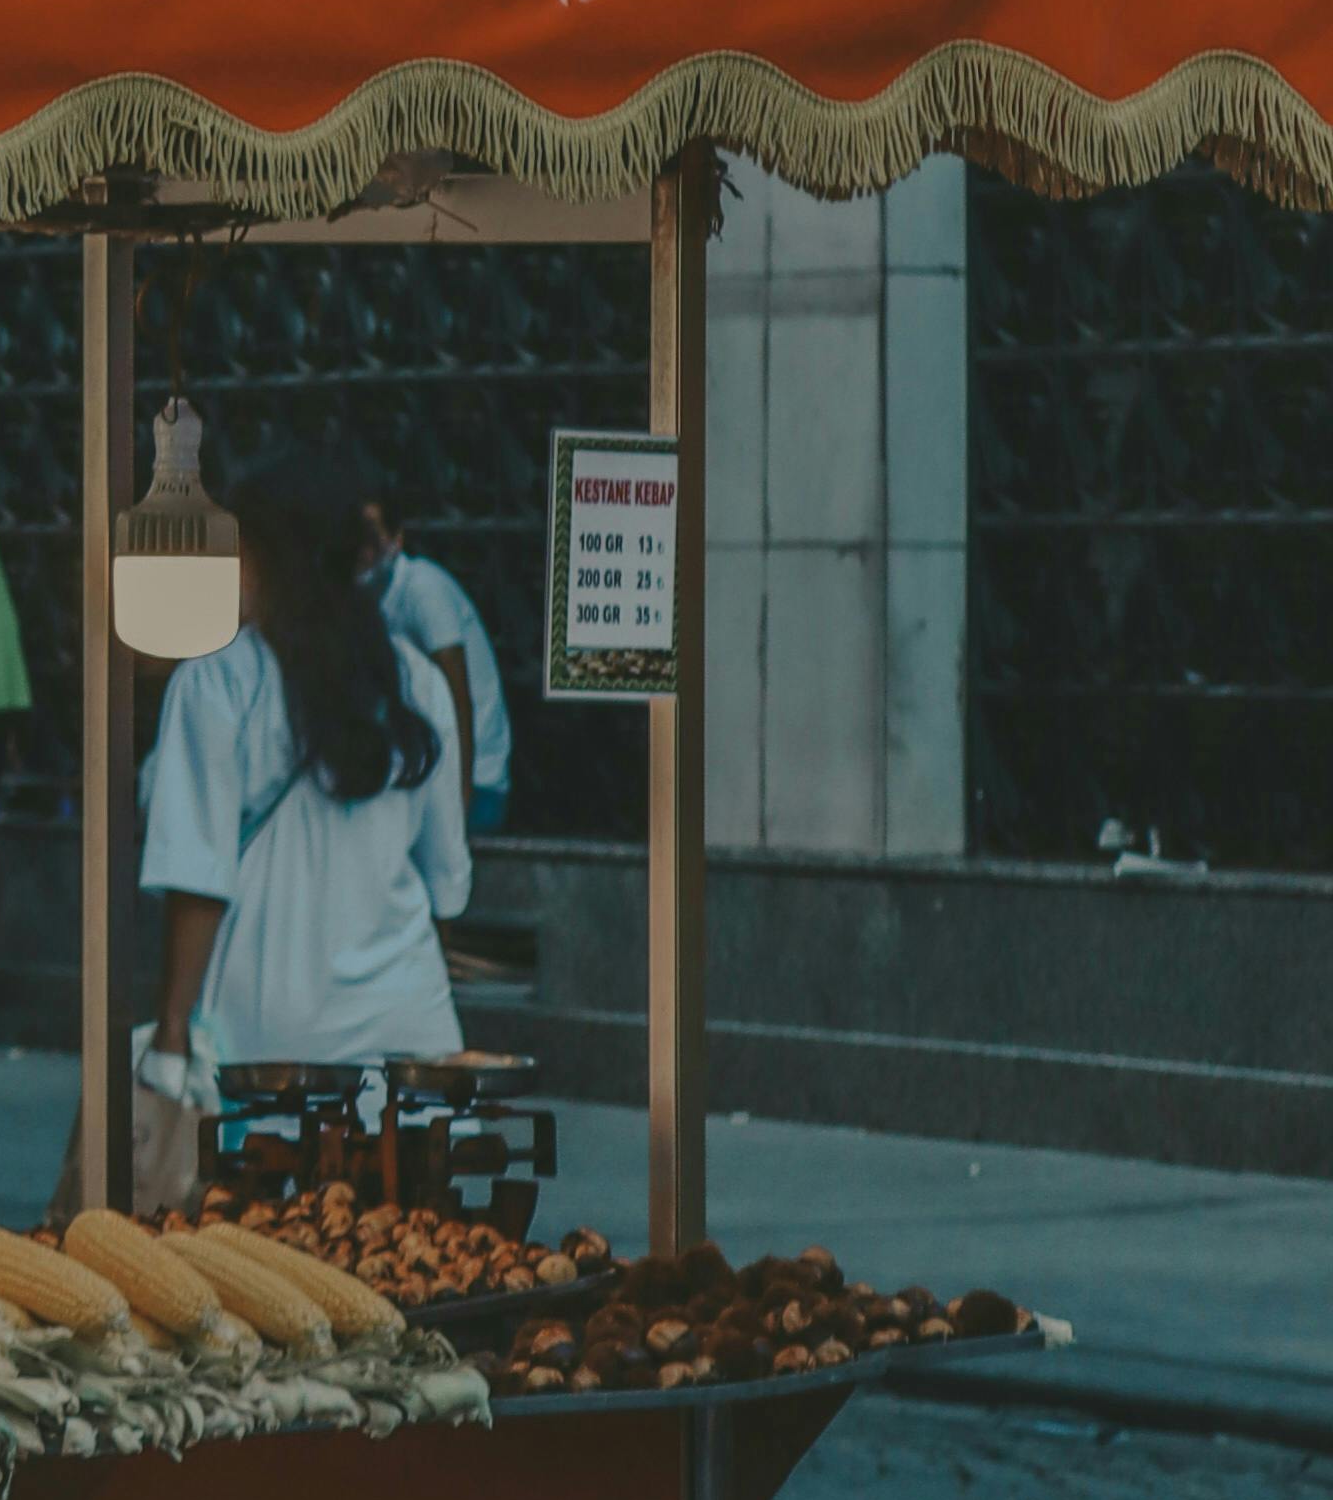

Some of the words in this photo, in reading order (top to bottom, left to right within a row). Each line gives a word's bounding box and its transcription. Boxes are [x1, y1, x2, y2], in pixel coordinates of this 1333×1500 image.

[574, 477, 631, 505] KESTANE
[635, 479, 675, 507] KEBAP
[579, 532, 601, 552] 100
[605, 533, 623, 553] GR
[638, 534, 653, 554] 13
[577, 568, 600, 588] 200
[604, 569, 622, 589] GR
[636, 570, 652, 590] 25
[576, 604, 599, 624] 300
[603, 604, 621, 624] GR
[635, 605, 650, 625] 35
